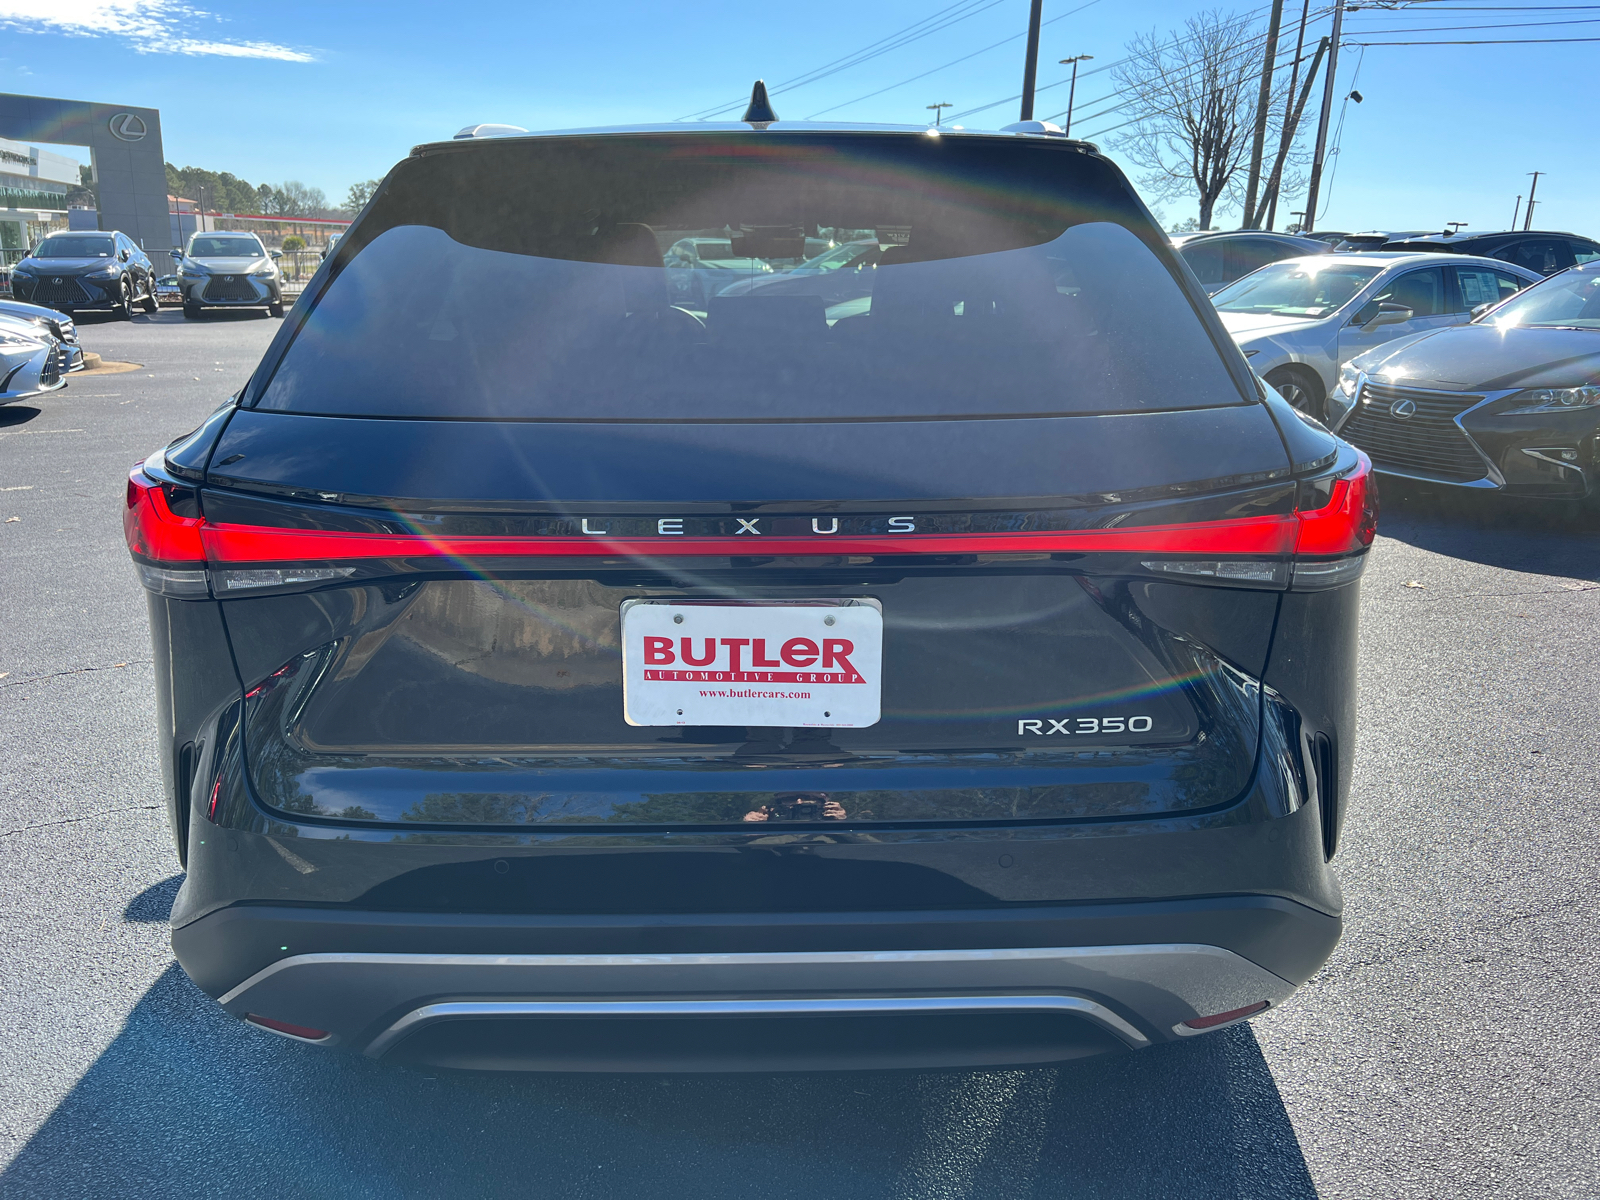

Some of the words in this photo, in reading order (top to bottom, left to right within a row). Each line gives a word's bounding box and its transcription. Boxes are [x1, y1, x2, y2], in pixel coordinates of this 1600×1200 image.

[581, 516, 916, 535] LEXUS
[645, 670, 774, 682] AUTOMOTIVE
[796, 673, 858, 683] GROUP
[699, 688, 811, 699] www.butlercars.com
